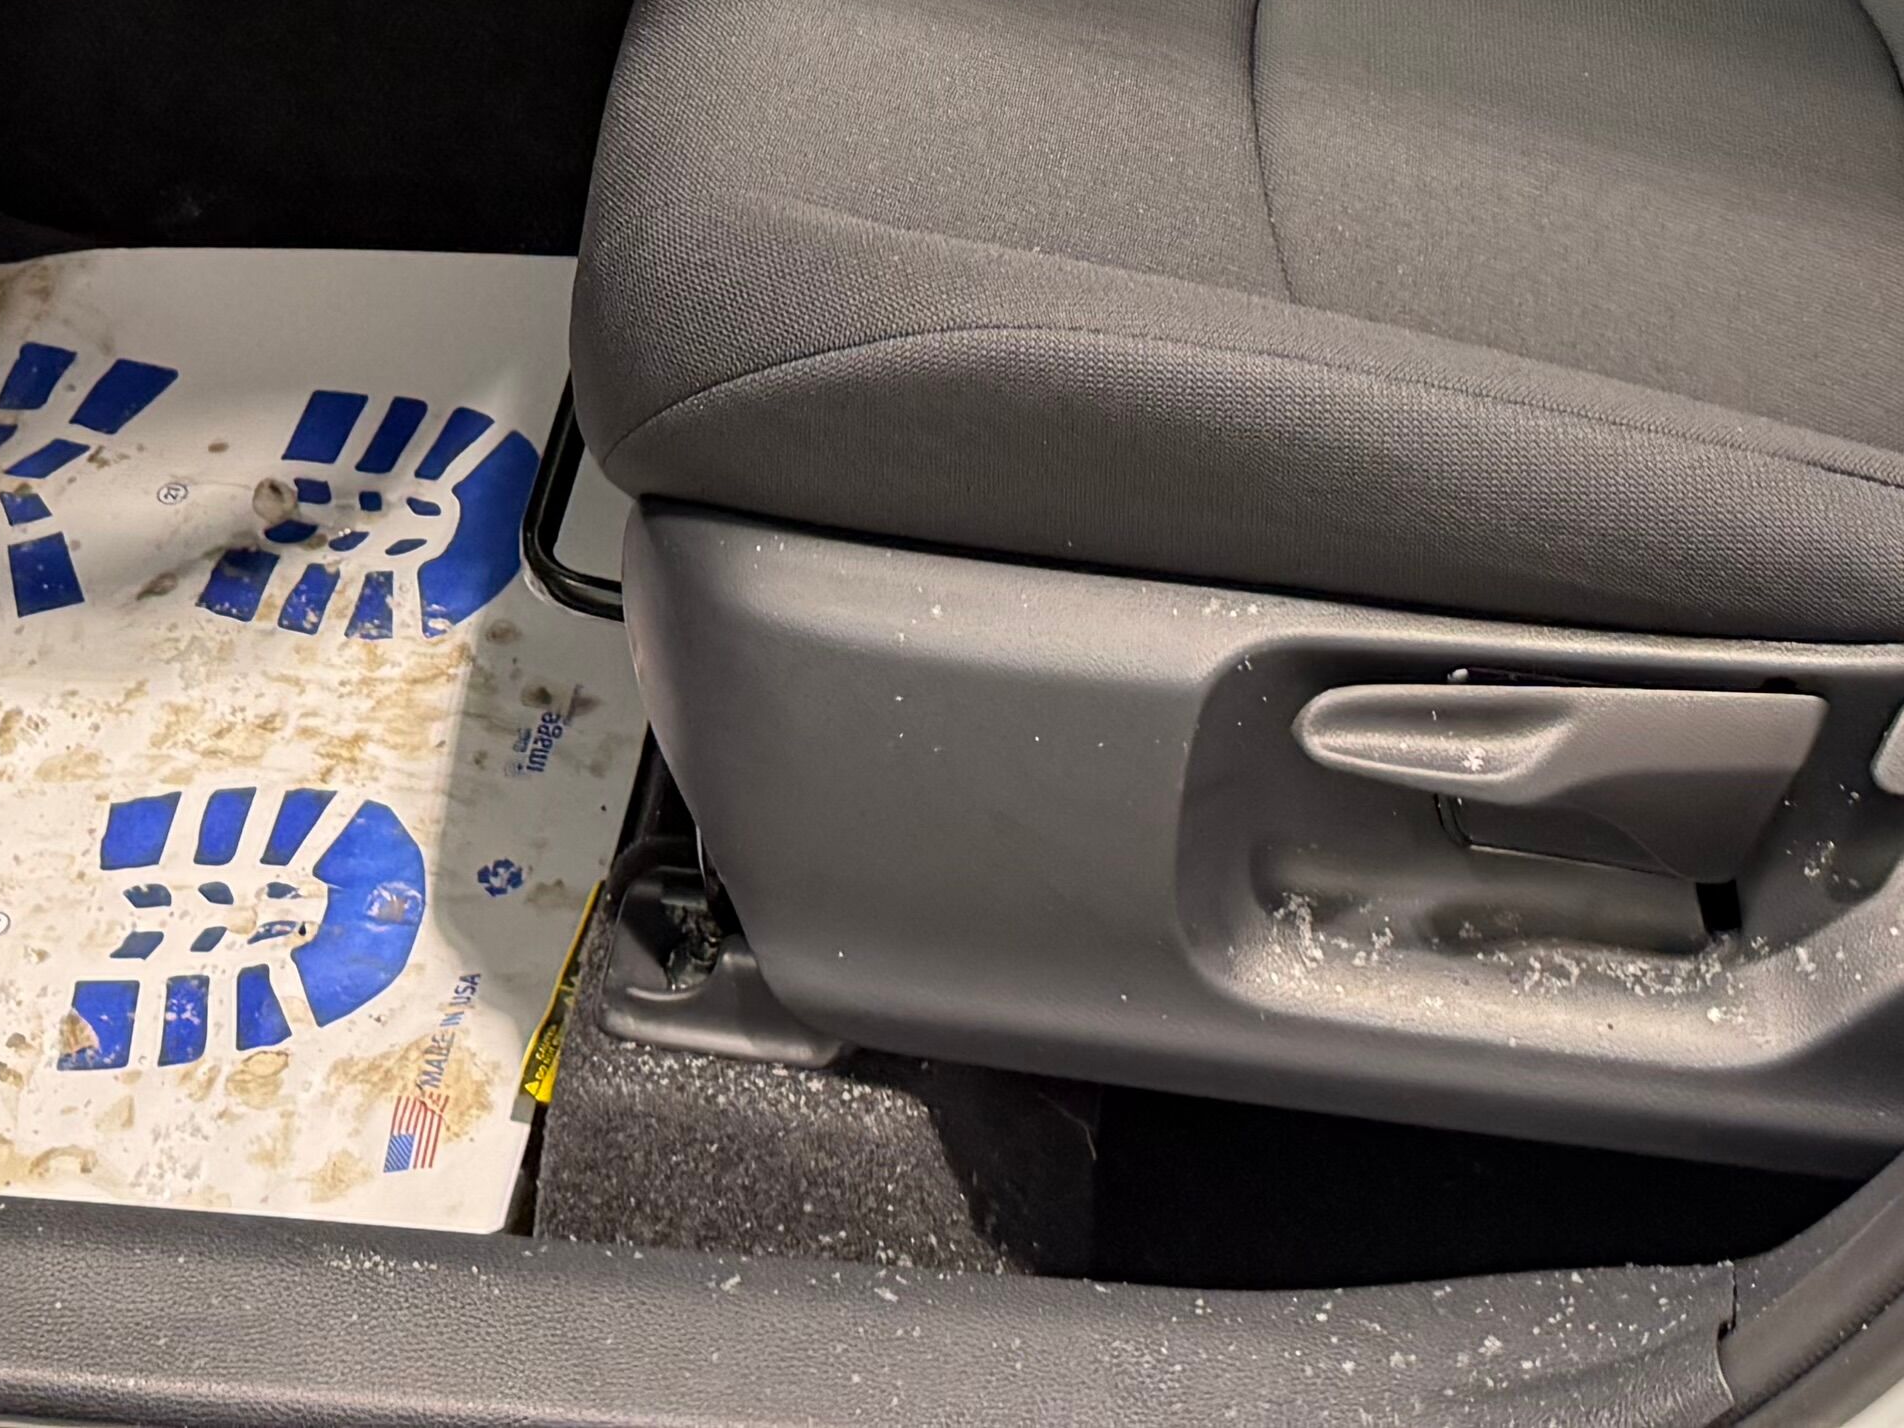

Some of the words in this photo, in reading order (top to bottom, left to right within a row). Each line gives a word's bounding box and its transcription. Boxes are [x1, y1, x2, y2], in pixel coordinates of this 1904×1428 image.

[526, 711, 567, 773] image
[420, 1030, 456, 1095] MADE
[440, 1001, 465, 1028] IN
[456, 972, 482, 1010] USA
